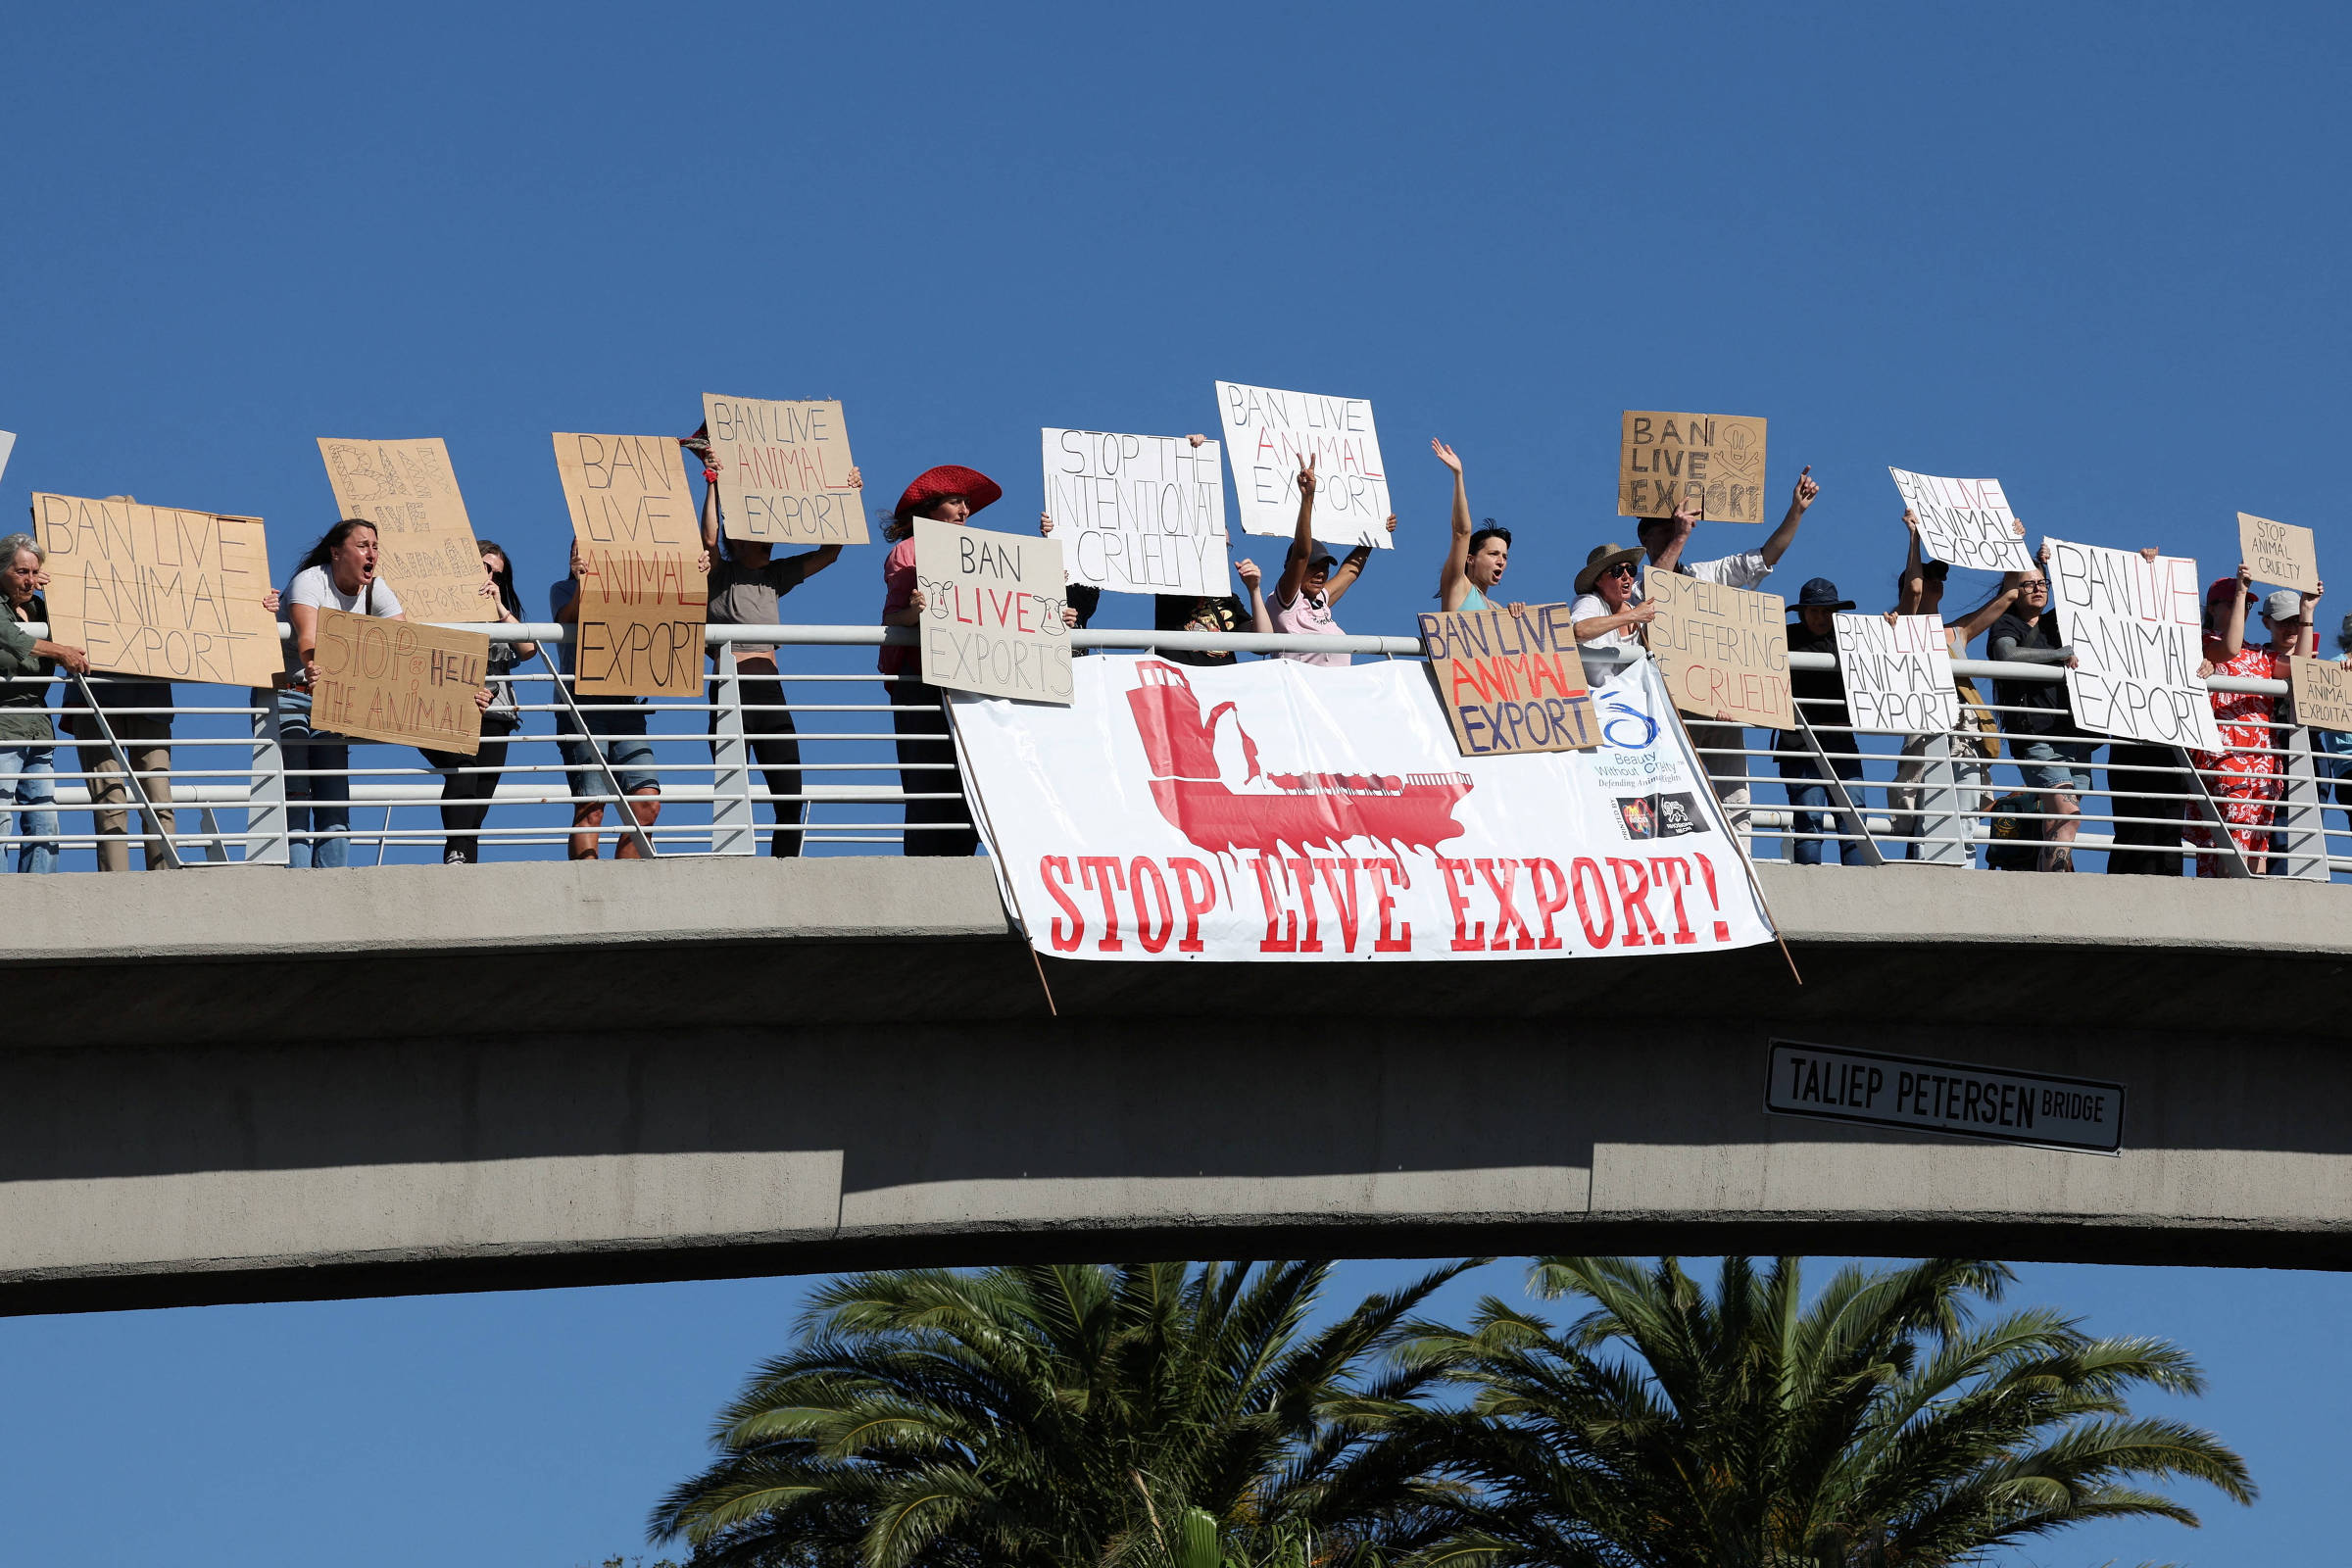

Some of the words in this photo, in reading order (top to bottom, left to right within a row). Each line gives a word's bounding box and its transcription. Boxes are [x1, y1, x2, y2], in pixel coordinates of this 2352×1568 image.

[714, 403, 766, 443] BAN
[774, 409, 829, 445] LIVE
[1228, 385, 1290, 429] BAN
[1303, 394, 1365, 431] LIVE
[1633, 416, 1715, 447] BAN
[328, 444, 452, 502] BAN
[578, 435, 671, 490] BAN
[738, 443, 851, 491] ANIMAL
[1061, 430, 1140, 478] STOP
[1147, 436, 1218, 484] THE
[1257, 426, 1383, 477] ANIMAL
[1632, 448, 1710, 479] LIVE
[1049, 473, 1226, 537] INTENTIONAL
[1630, 478, 1761, 521] EXPORT
[1890, 467, 1940, 507] BAN
[1940, 478, 2008, 510] LIVE
[42, 496, 135, 563] BAN
[151, 507, 250, 574] LIVE
[579, 495, 680, 543] LIVE
[744, 493, 853, 538] EXPORT
[1917, 501, 2024, 541] ANIMAL
[2257, 520, 2286, 542] STOP
[960, 536, 1021, 582] BAN
[1077, 530, 1206, 594] CRUELTY
[1928, 530, 2026, 570] EXPORT
[2252, 537, 2292, 562] ANIMAL
[2258, 557, 2301, 580] CRUELTY
[83, 560, 258, 636] ANIMAL
[394, 583, 488, 618] XPORT
[580, 548, 707, 607] ANIMAL
[1650, 570, 1726, 616] SMELL
[1733, 588, 1780, 625] THE
[2056, 545, 2132, 616] BAN
[2134, 555, 2200, 626] LIVE
[955, 585, 1036, 634] LIVE
[1420, 612, 1491, 661] BAN
[1492, 605, 1577, 657] LIVE
[1835, 613, 1887, 654] BAN
[1892, 614, 1948, 654] LIVE
[83, 620, 248, 683] EXPORT
[323, 612, 418, 681] STOP
[430, 649, 480, 688] HELL
[580, 621, 707, 690] EXPORT
[929, 627, 1073, 698] EXPORTS
[1652, 611, 1790, 672] SUFFERING
[2072, 612, 2206, 692] ANIMAL
[1452, 652, 1587, 707] ANIMAL
[1686, 664, 1791, 717] CRUELTY
[1848, 653, 1955, 693] ANIMAL
[2306, 662, 2342, 688] END
[2307, 683, 2352, 706] ANIMAL
[322, 680, 357, 725] THE
[1459, 696, 1590, 754] EXPORT
[2075, 671, 2205, 748] EXPORT
[2298, 701, 2352, 723] EXPLOITA
[1594, 765, 1640, 777] Without
[1614, 751, 1656, 765] Beauty
[1598, 778, 1636, 789] Defending
[1040, 855, 1217, 954] STOP
[1247, 857, 1412, 954] LIVE
[1435, 852, 1733, 952] EXPORT!
[1789, 1056, 1884, 1109] TALIEP
[1896, 1070, 2036, 1129] PETERSEN
[2040, 1089, 2105, 1124] BRIDGE
